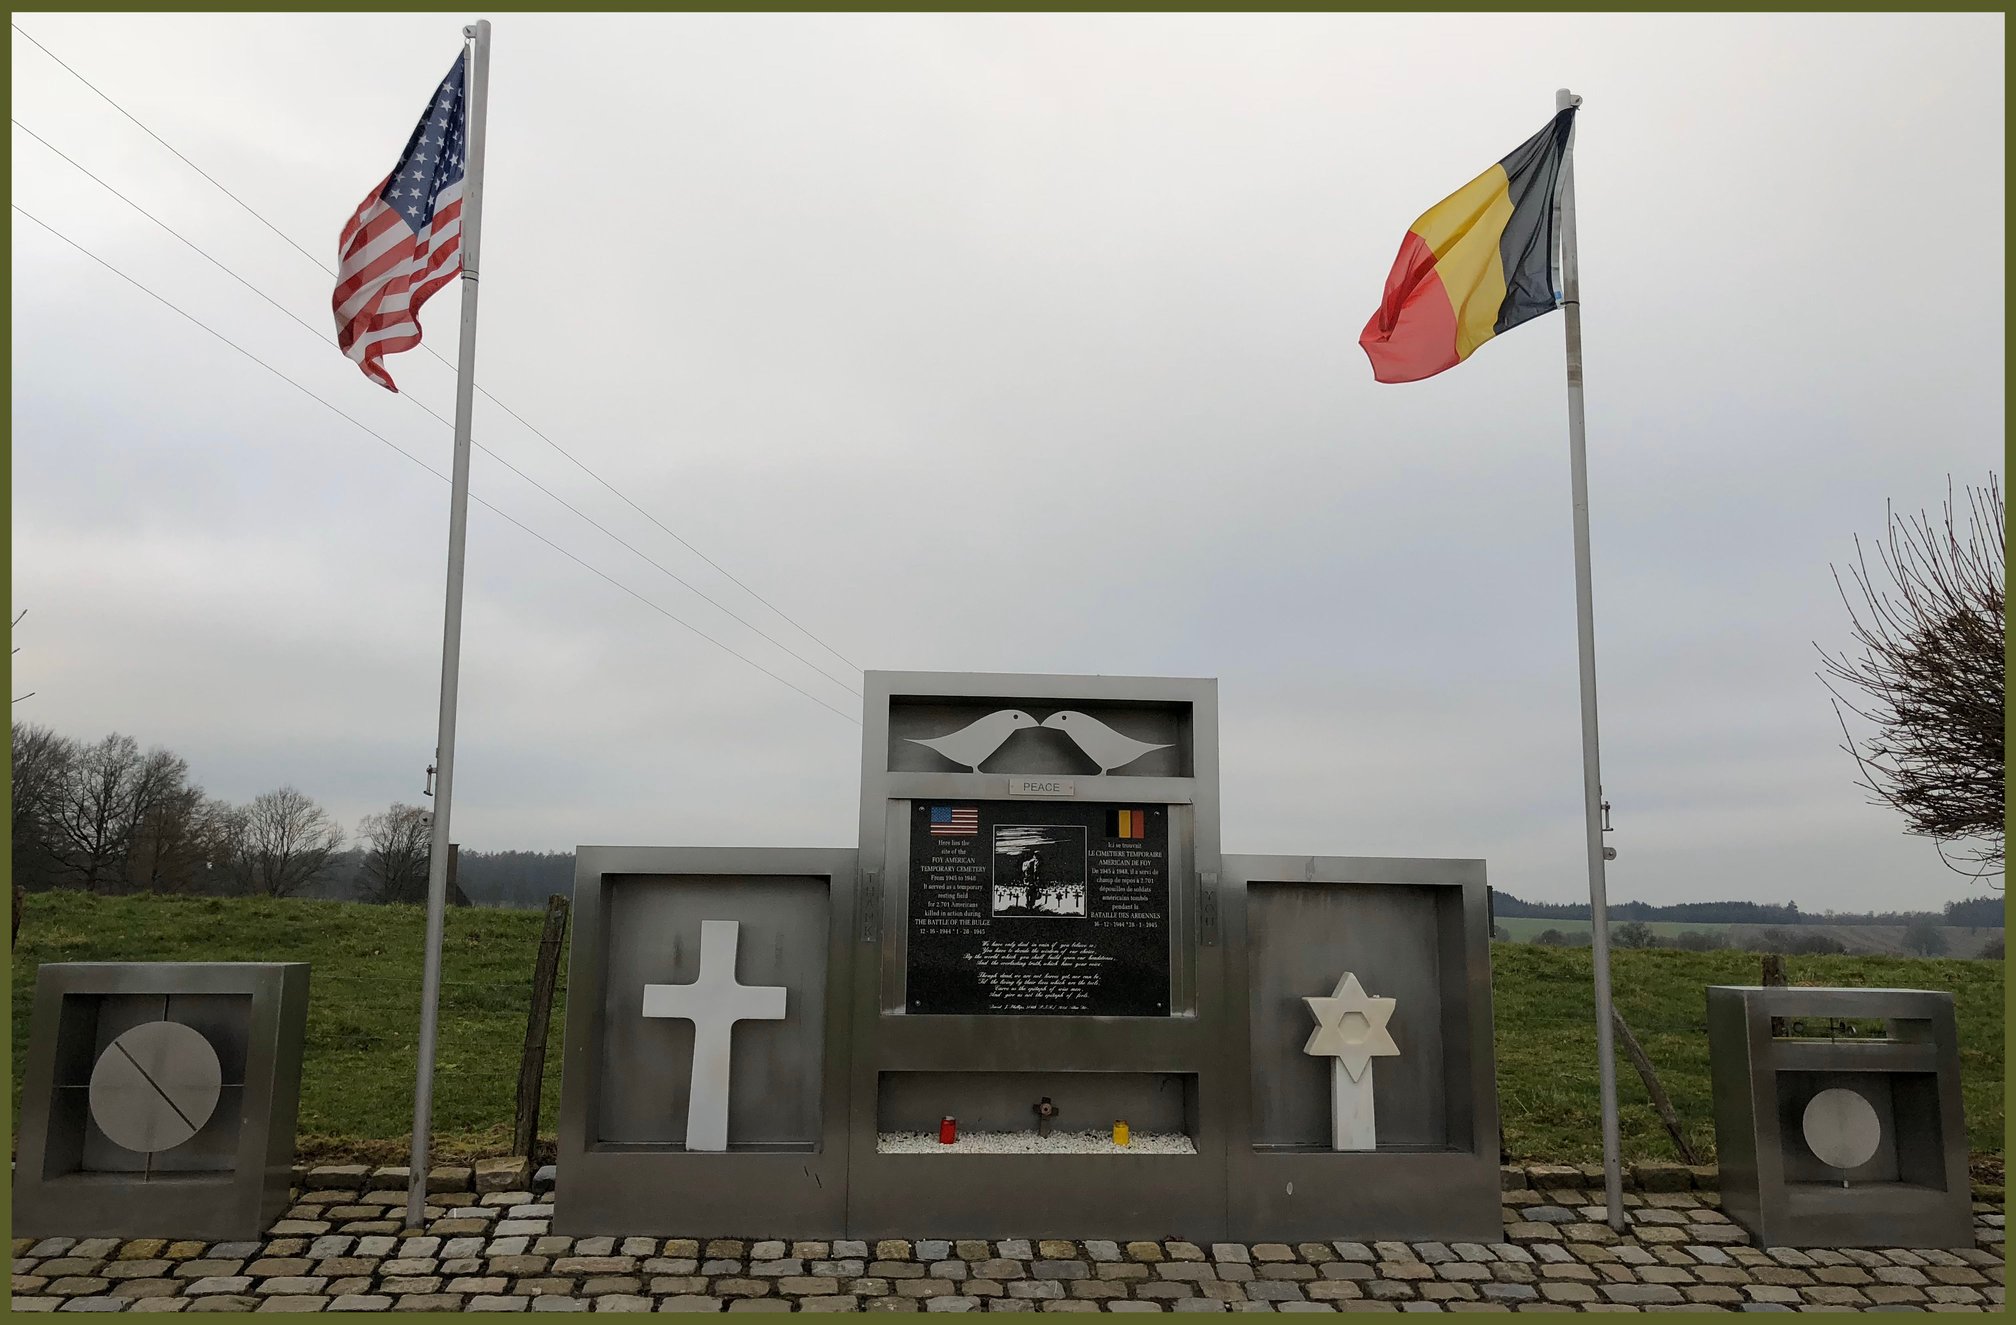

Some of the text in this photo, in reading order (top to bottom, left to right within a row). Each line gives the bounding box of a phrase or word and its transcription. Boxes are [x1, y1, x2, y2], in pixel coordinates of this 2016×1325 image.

[1023, 782, 1060, 792] PEACE
[1126, 850, 1162, 858] TEMPORAIRE
[1096, 876, 1113, 885] champ
[956, 884, 983, 892] temporary
[1099, 885, 1126, 893] dépouilles
[864, 872, 876, 936] THANK
[1112, 903, 1133, 911] pendant
[964, 910, 981, 918] during
[982, 946, 993, 955] You
